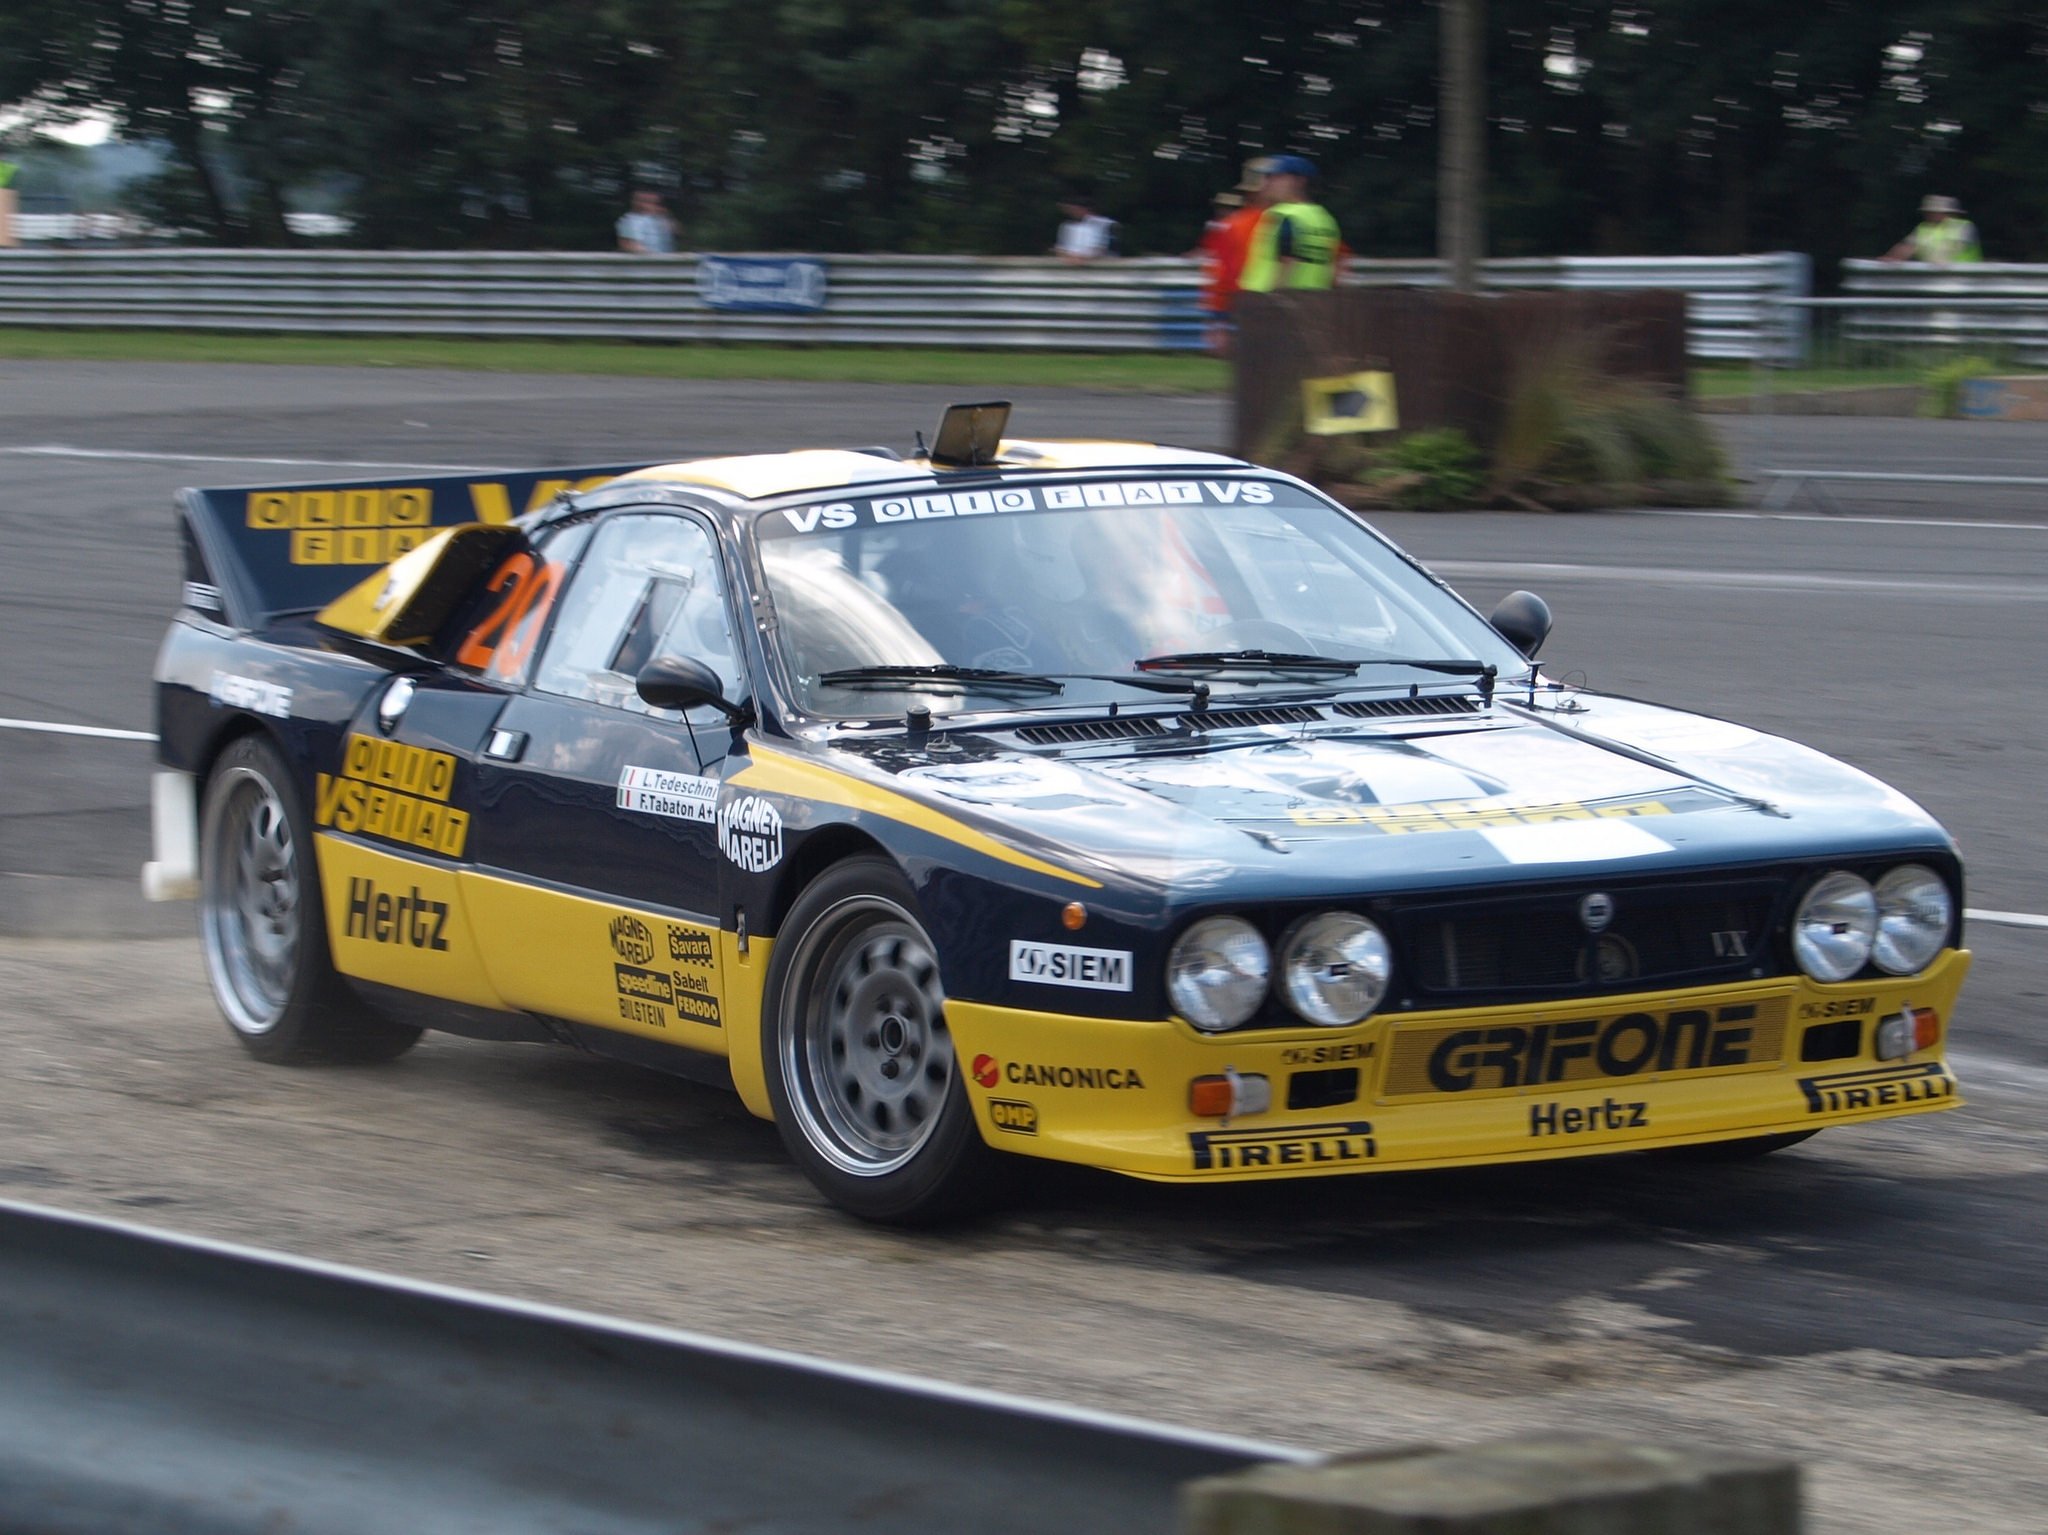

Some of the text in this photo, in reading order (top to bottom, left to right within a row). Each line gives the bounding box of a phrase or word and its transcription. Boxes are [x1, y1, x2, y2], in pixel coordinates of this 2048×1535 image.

[254, 492, 428, 526] OLIO
[784, 482, 1274, 532] VS OLIO FIAT VS
[300, 531, 422, 562] FIA
[348, 736, 453, 795] OLIO
[718, 796, 782, 838] MAGNETI
[718, 834, 782, 873] MARELLI
[346, 875, 450, 952] Hertz
[670, 936, 711, 955] Savara
[673, 970, 709, 993] Sabelt
[1050, 951, 1125, 984] SIEM
[677, 994, 719, 1021] FERODO
[1312, 1042, 1376, 1064] SIEM
[1429, 1004, 1756, 1092] GRIFONE
[1006, 1061, 1146, 1089] CANONICA
[1797, 1062, 1954, 1113] PIRELLI
[992, 1102, 1037, 1128] OMP
[1531, 1097, 1648, 1137] Hertz
[1187, 1121, 1377, 1170] PIRELLI
